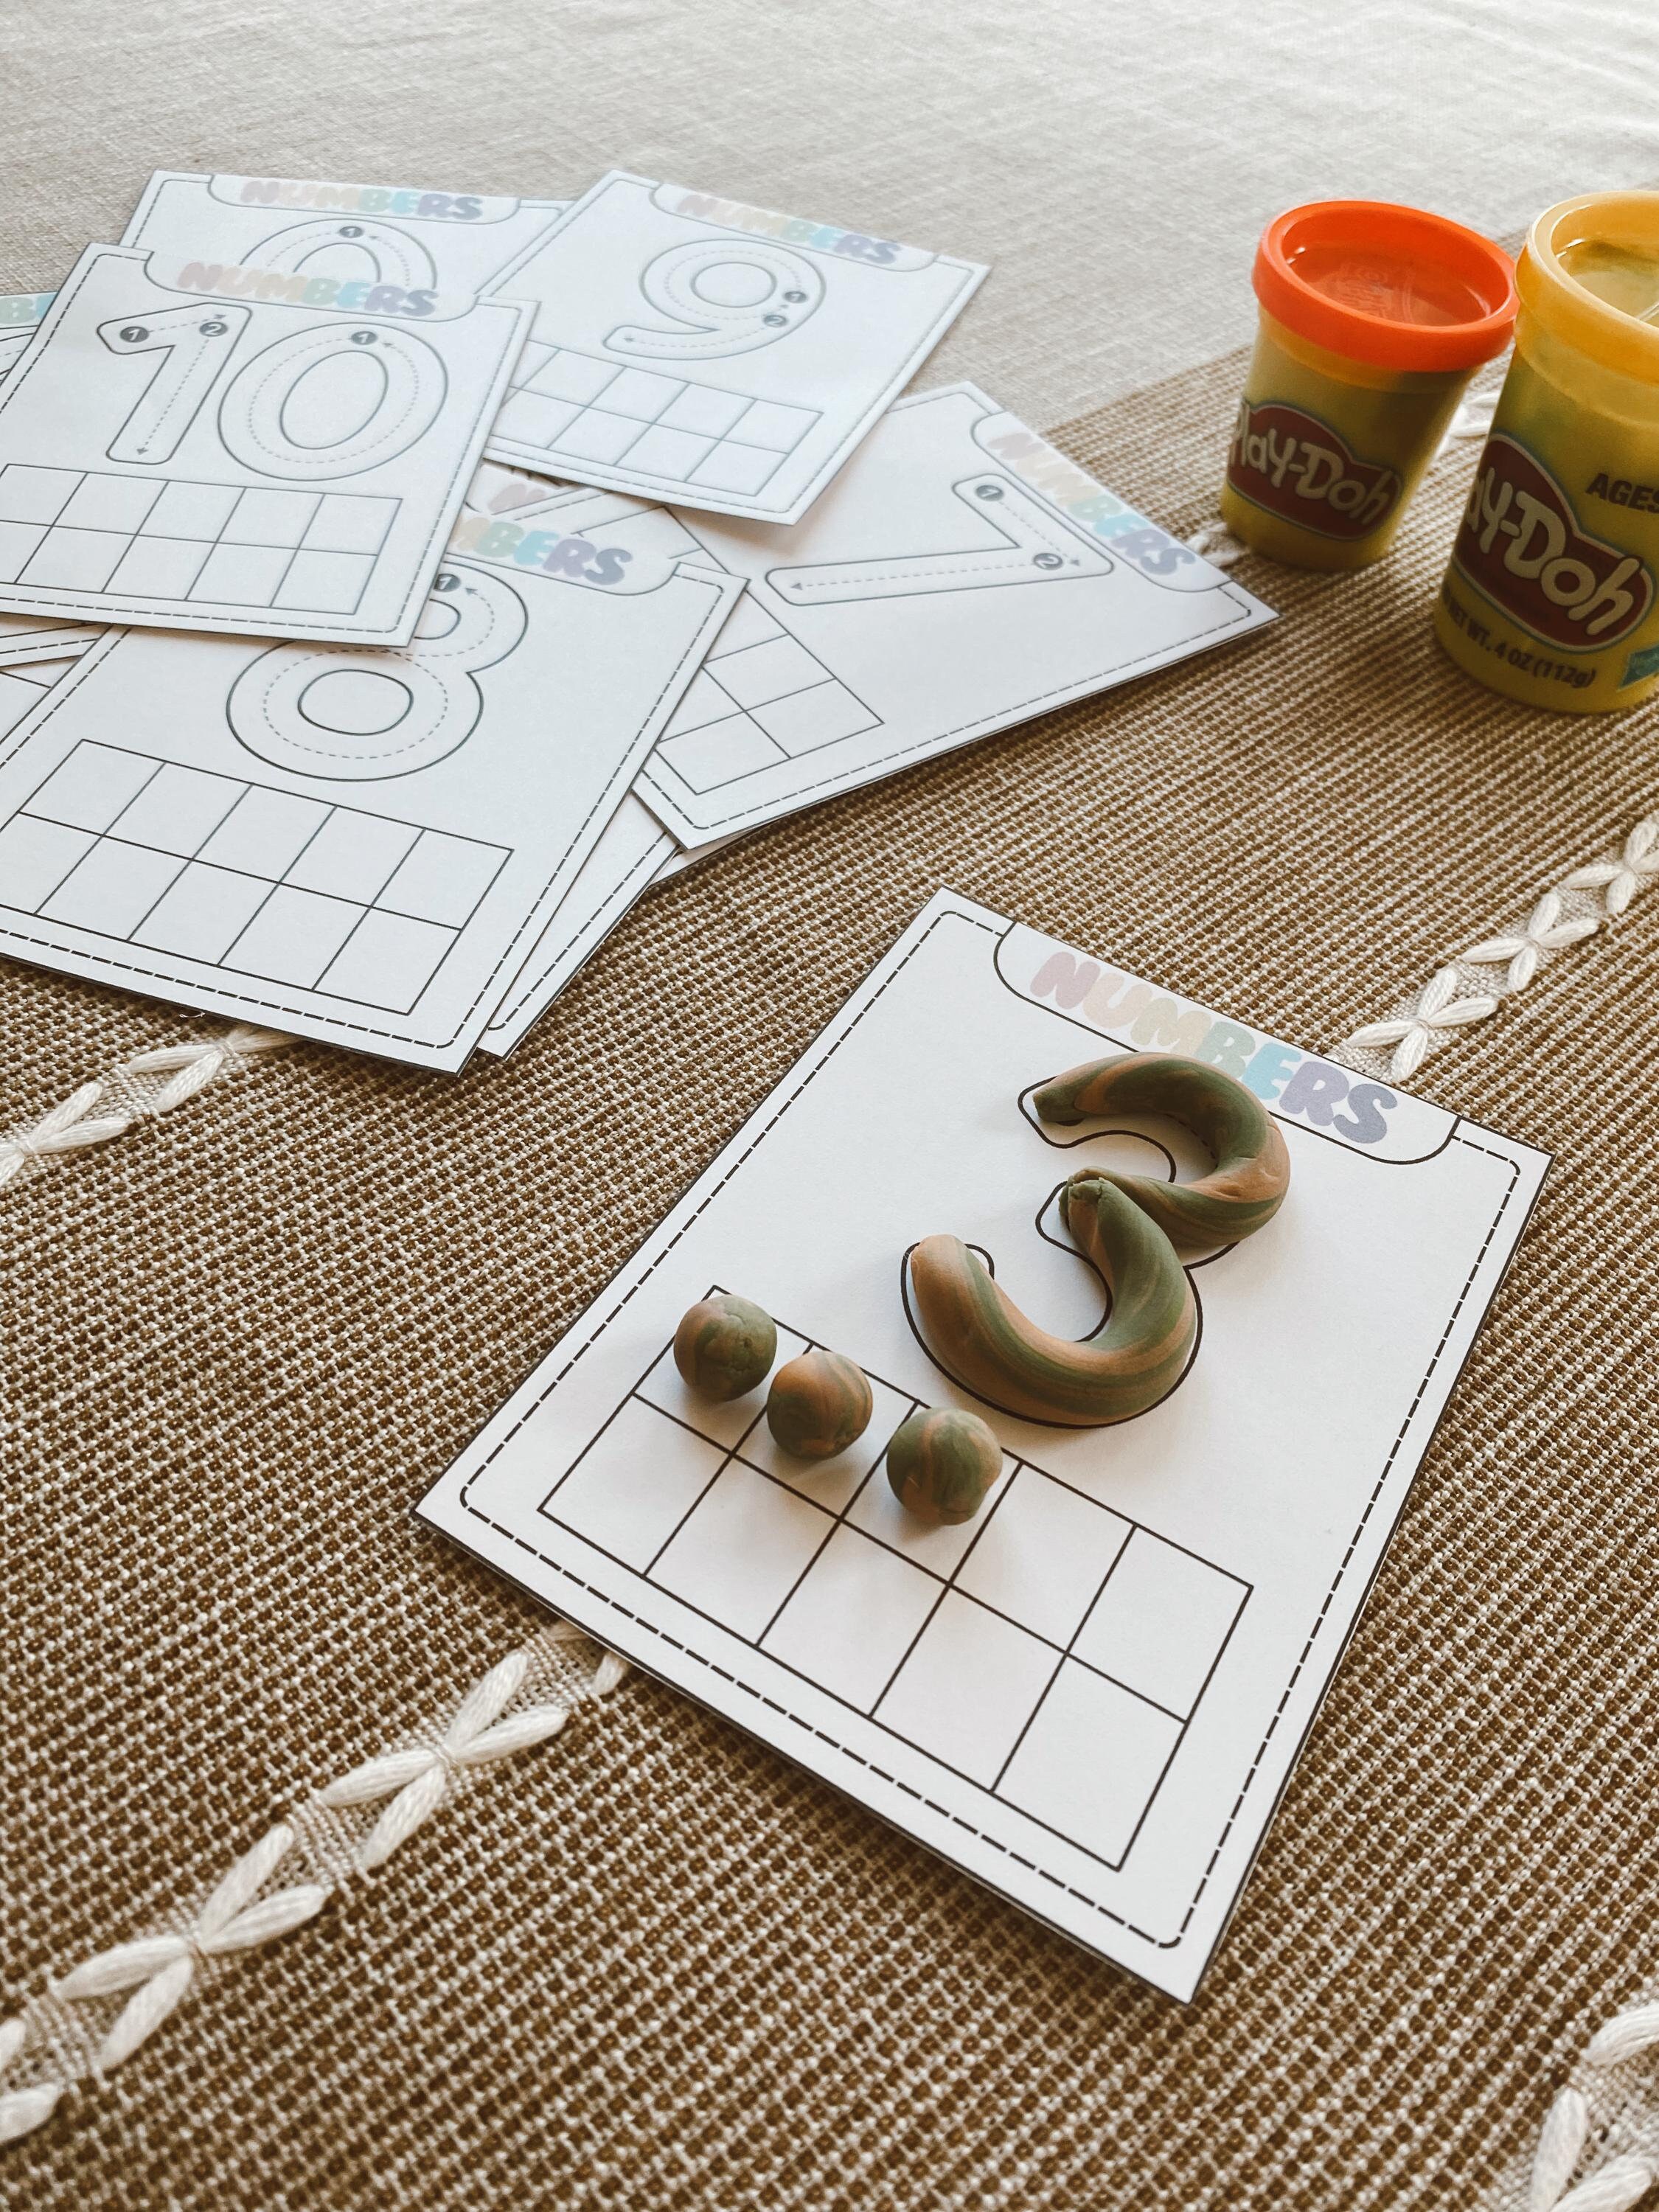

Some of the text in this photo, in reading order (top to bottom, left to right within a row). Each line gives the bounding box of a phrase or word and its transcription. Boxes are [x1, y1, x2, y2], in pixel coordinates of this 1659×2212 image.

[178, 261, 439, 317] NUMBERS
[603, 238, 827, 361] 9
[97, 302, 448, 481] 10
[1508, 649, 1534, 671] OZ
[1533, 658, 1596, 689] (112g)
[1029, 951, 1398, 1144] NUMBERS
